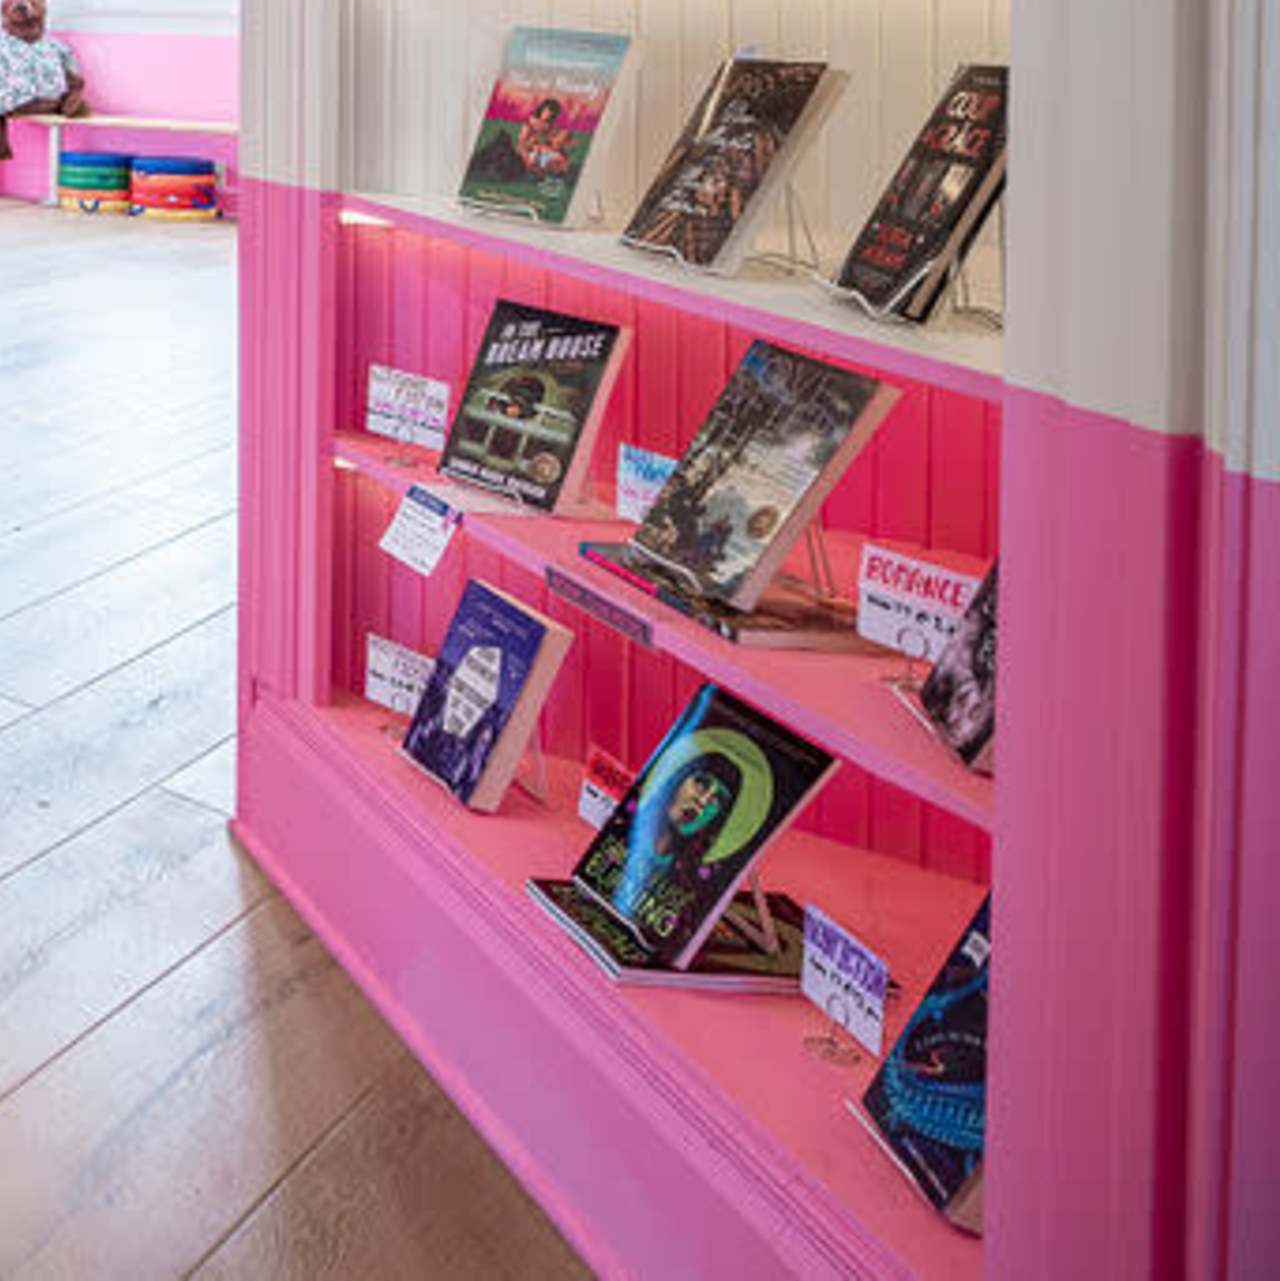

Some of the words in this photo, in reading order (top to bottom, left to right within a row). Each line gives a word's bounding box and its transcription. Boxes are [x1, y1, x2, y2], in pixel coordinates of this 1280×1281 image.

[485, 337, 545, 365] DREAM
[545, 333, 606, 360] HOUSE
[866, 555, 967, 606] ROMANCE
